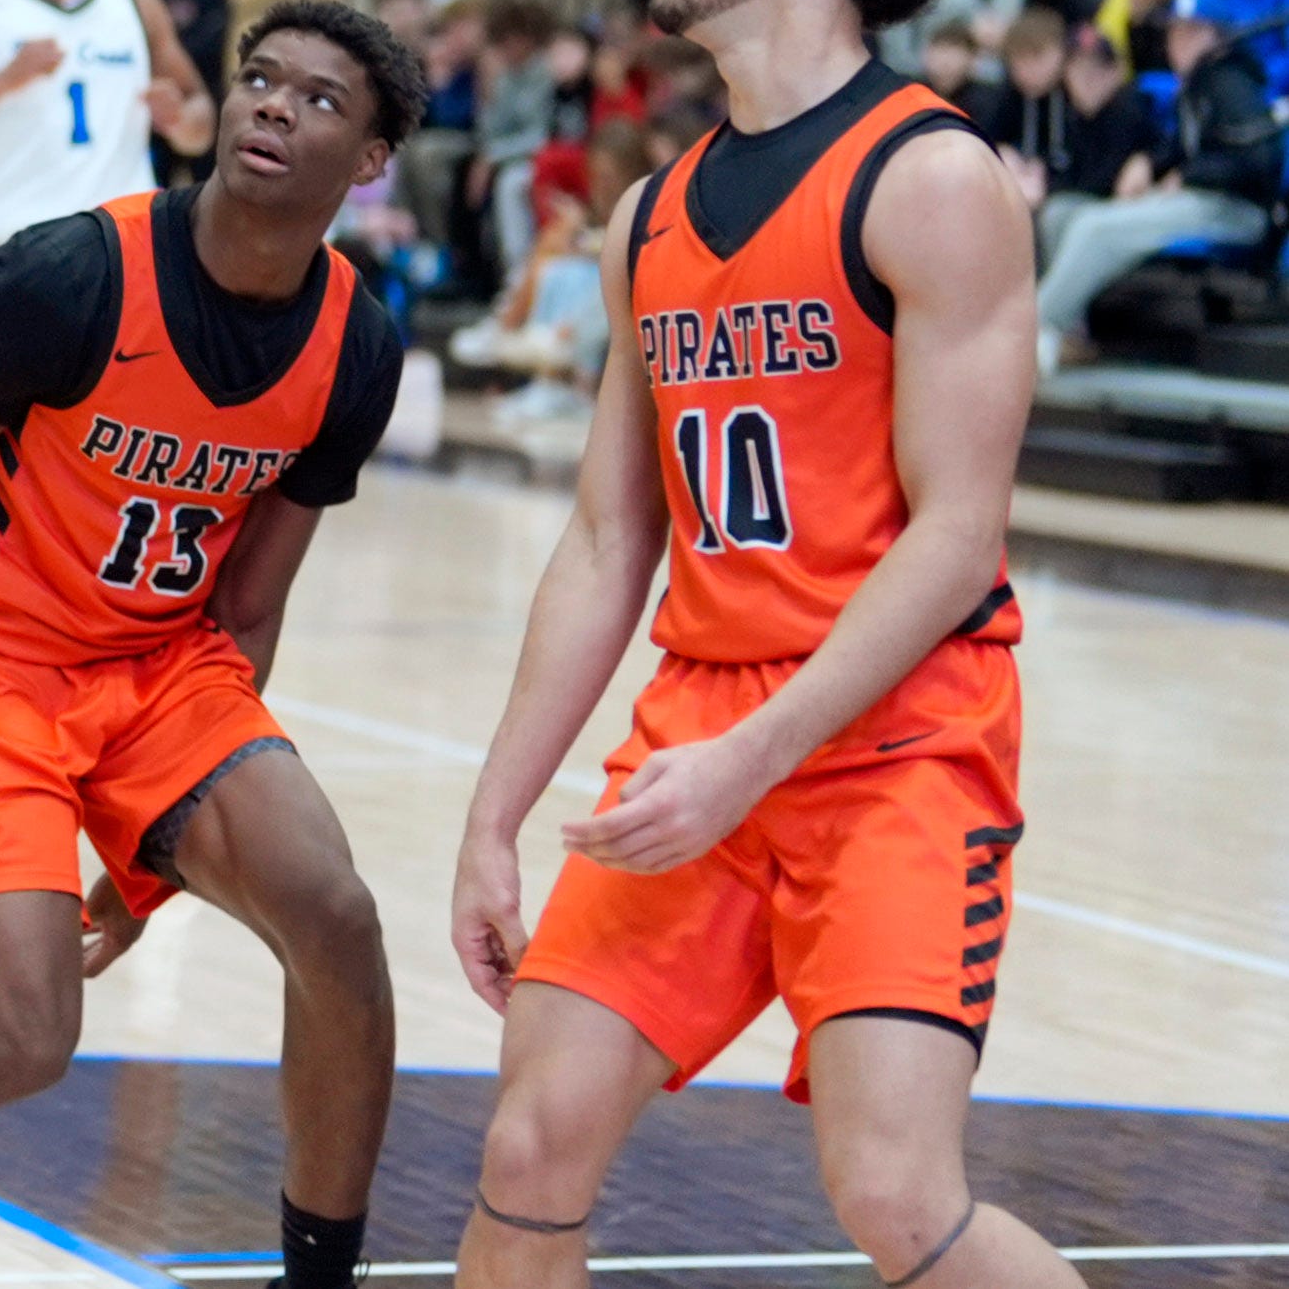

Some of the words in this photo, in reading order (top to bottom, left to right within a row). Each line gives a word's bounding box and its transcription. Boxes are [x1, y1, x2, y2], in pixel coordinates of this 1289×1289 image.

[67, 81, 91, 145] 1
[638, 298, 844, 390] PIRATES
[673, 404, 794, 555] 10
[97, 494, 225, 599] 13
